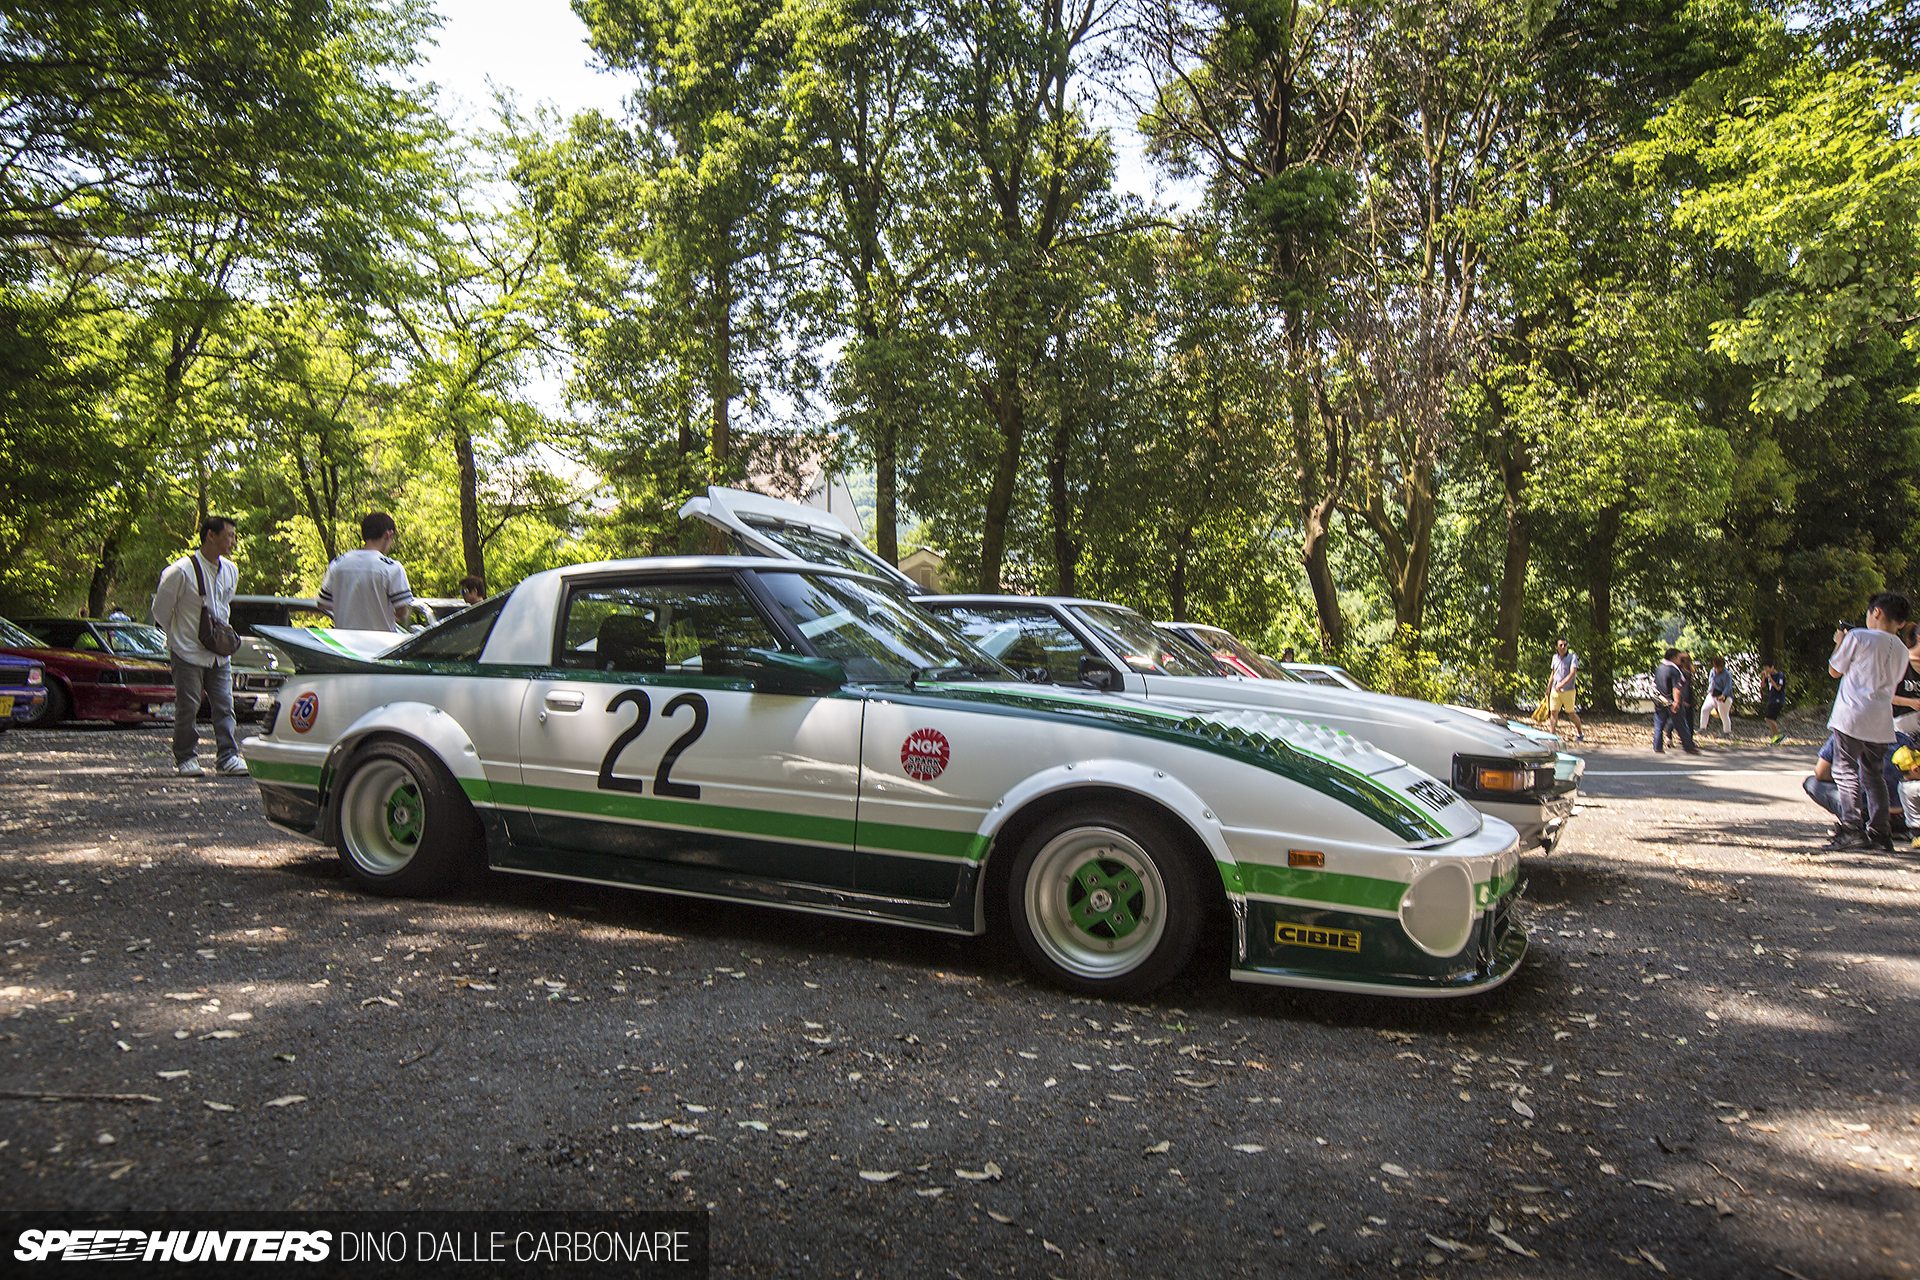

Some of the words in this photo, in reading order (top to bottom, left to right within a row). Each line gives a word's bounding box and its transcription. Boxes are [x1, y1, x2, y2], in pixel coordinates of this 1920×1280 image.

[292, 696, 315, 719] 76
[597, 689, 709, 799] 22
[908, 738, 943, 755] NGK
[907, 762, 939, 775] PLUGS
[908, 754, 940, 766] SPARK
